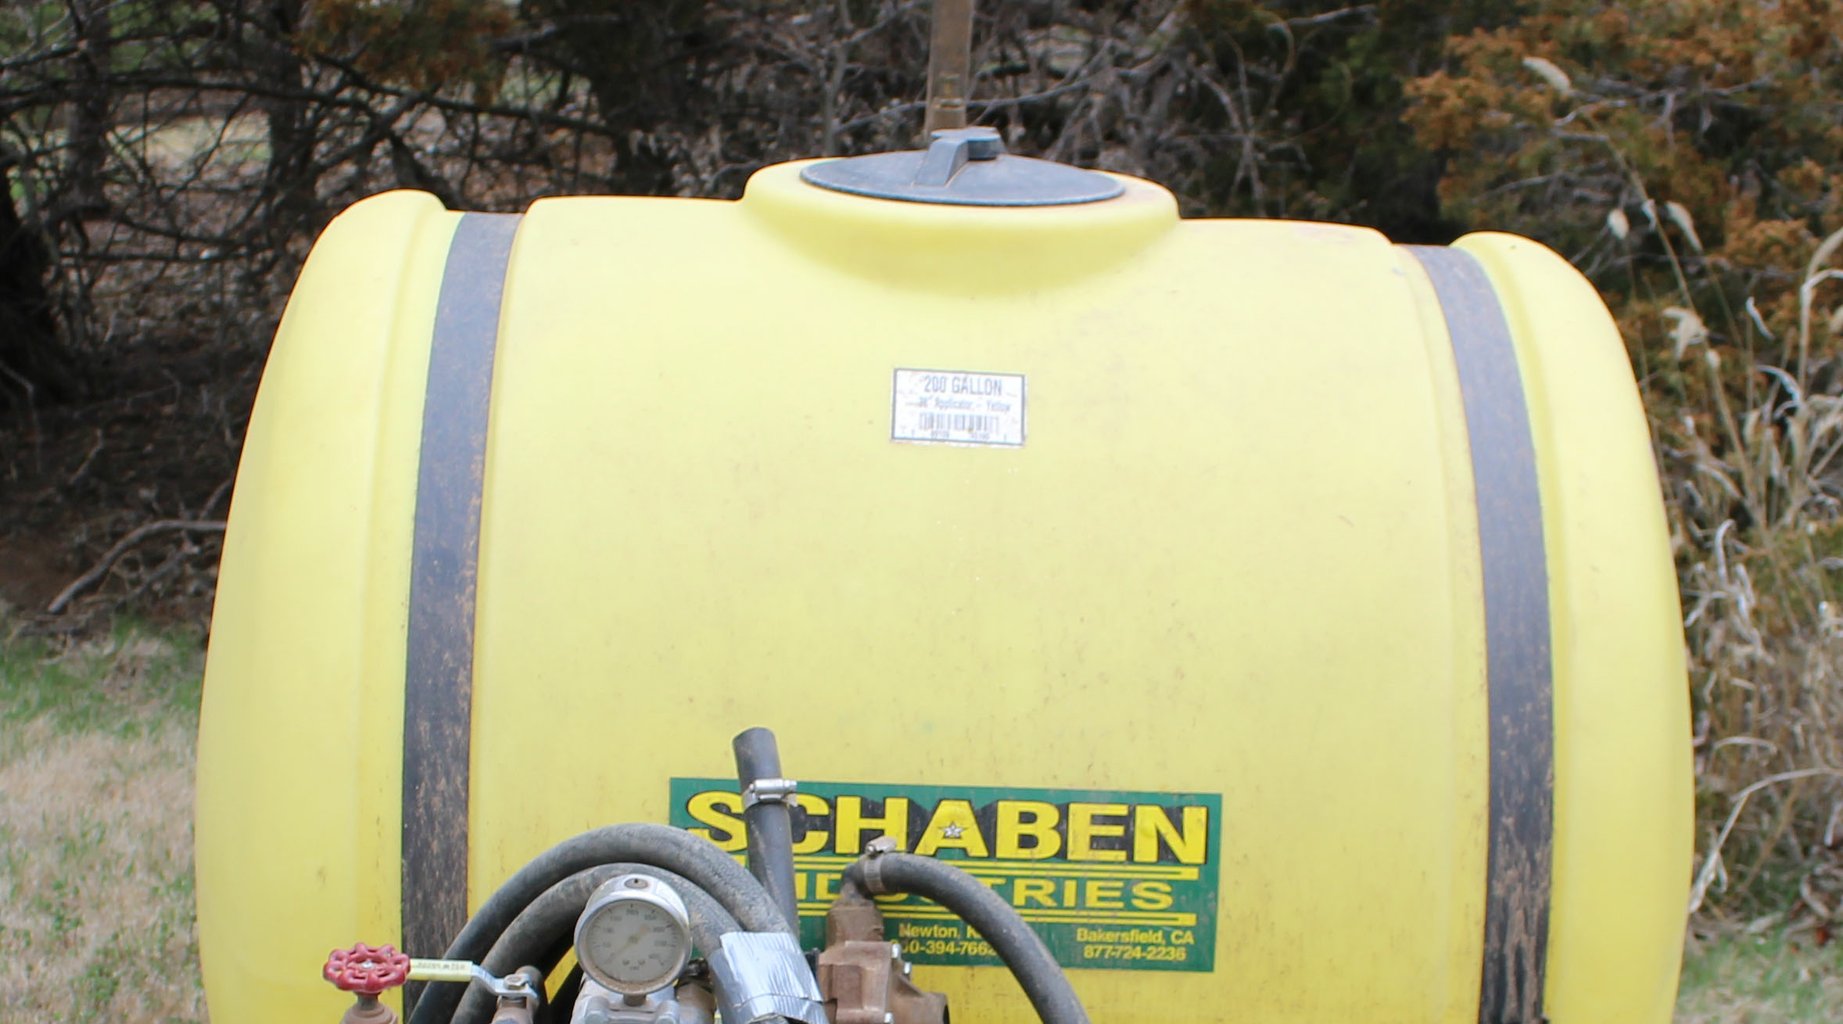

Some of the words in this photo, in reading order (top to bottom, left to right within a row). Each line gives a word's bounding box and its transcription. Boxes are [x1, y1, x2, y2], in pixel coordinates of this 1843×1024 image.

[924, 375, 947, 393] 200
[952, 376, 1002, 396] GALLON
[687, 790, 1208, 865] SCHABEN
[899, 923, 961, 939] Newton,
[1077, 927, 1166, 945] Bakersfield,
[1170, 930, 1195, 944] CA
[1084, 944, 1187, 961] 877-724-2236
